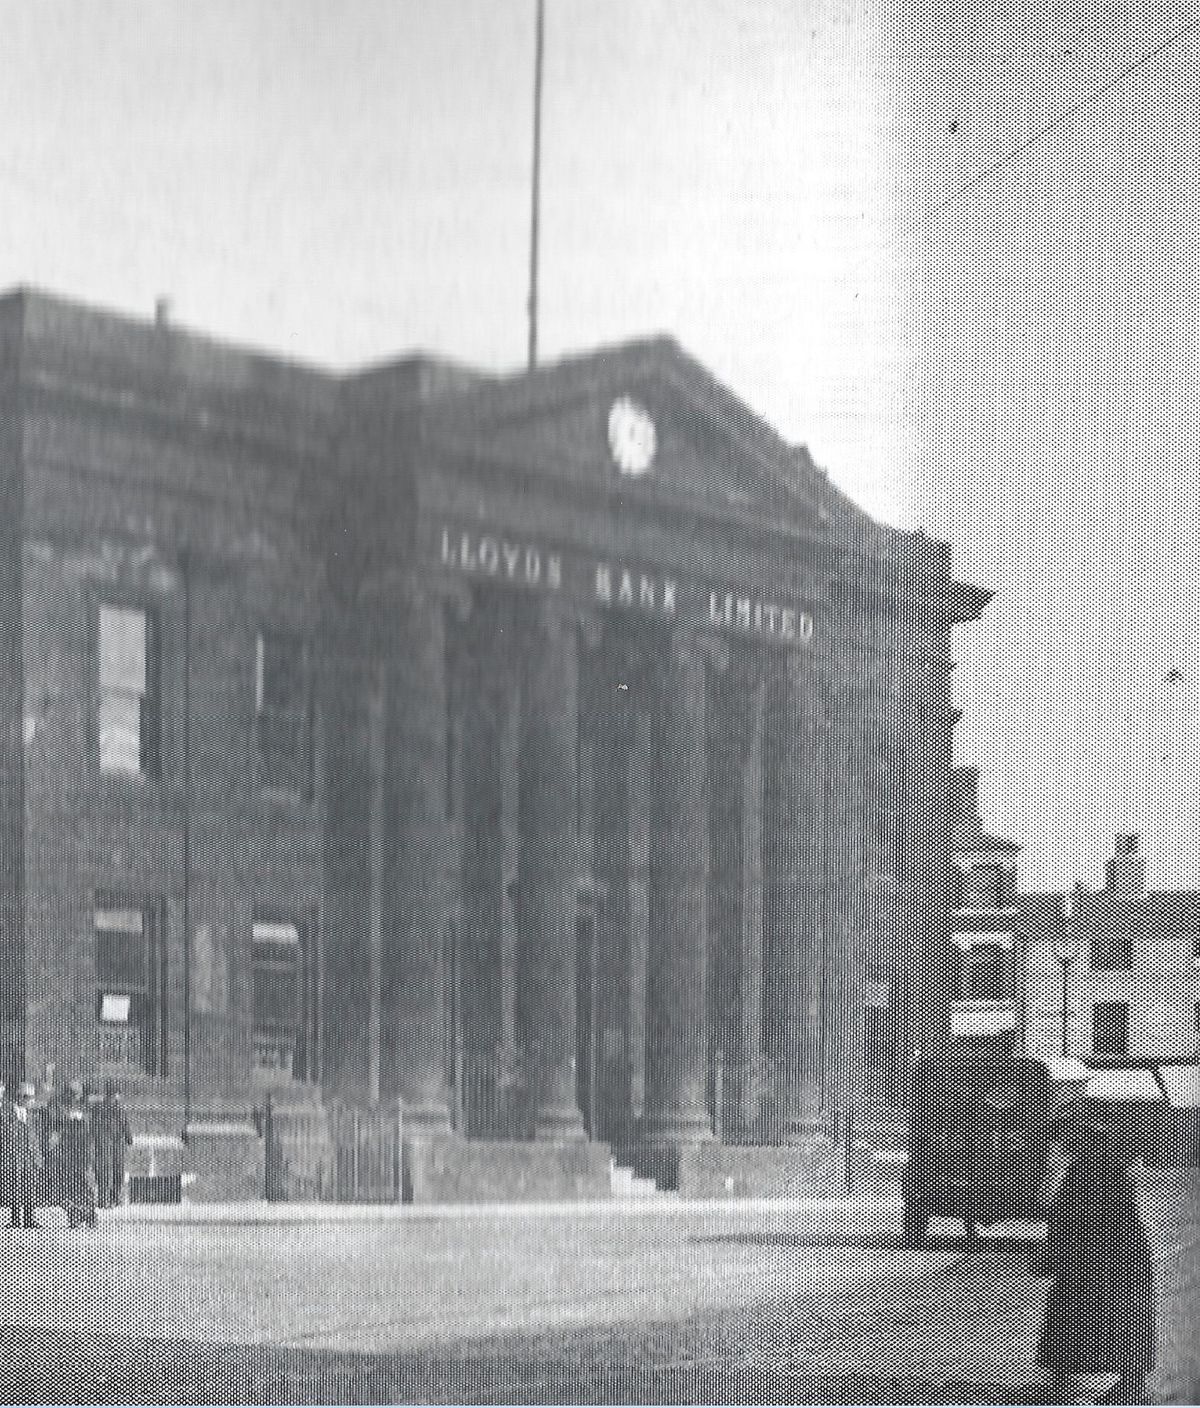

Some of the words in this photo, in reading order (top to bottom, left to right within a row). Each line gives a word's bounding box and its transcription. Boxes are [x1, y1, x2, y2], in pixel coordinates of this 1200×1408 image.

[440, 524, 563, 590] LLOYDS
[594, 560, 677, 616] BANK
[708, 588, 814, 644] LIMITED
